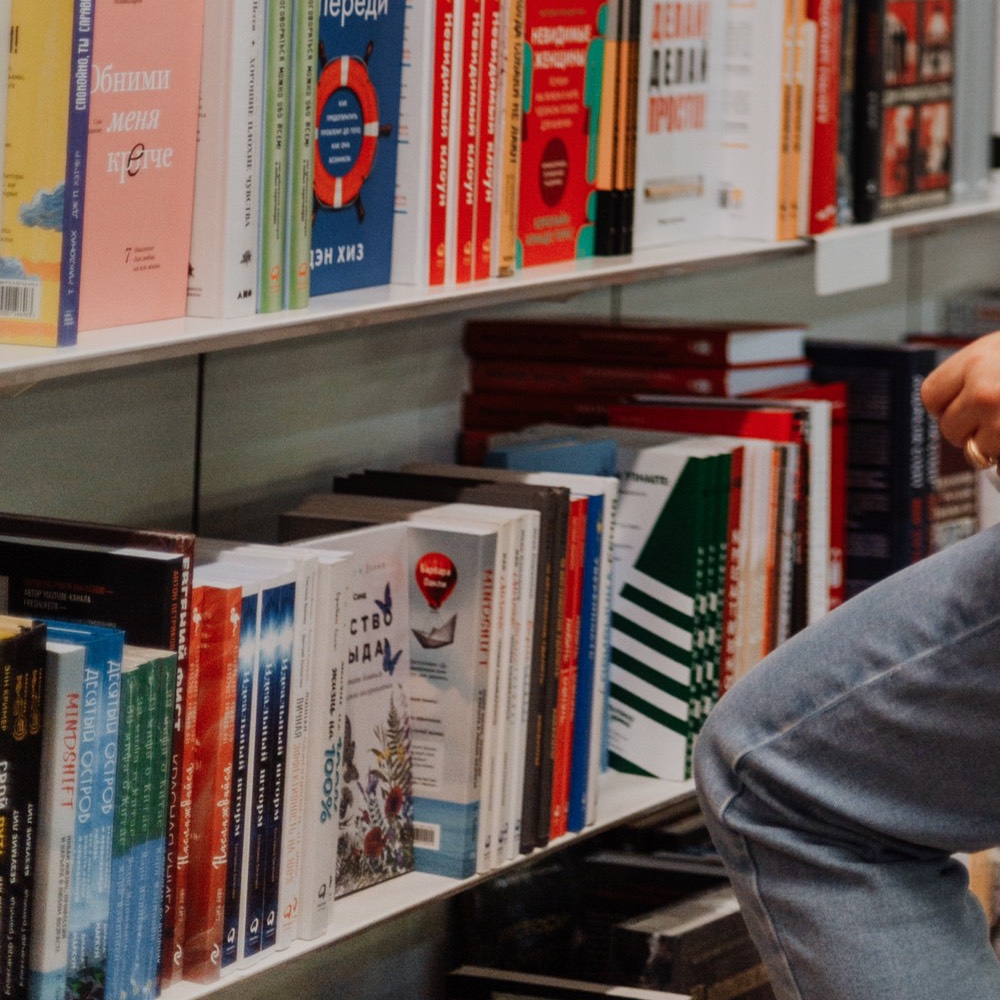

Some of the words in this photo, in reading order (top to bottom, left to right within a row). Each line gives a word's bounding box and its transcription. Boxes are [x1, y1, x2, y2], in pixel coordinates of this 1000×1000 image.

[78, 38, 90, 54] ТЫ
[75, 55, 91, 111] СПОКОЙНО,
[247, 57, 257, 119] ХОРОШИЕ
[277, 66, 286, 98] МОЖНО
[305, 65, 313, 97] МОЖНО
[106, 108, 160, 133] меня
[276, 102, 284, 119] ОБО
[303, 121, 312, 148] ВСЕМ!
[304, 100, 312, 117] ОБО
[245, 121, 255, 172] ПЛОХИЕ
[275, 123, 284, 150] ВСЕМ!
[243, 175, 253, 229] ЧУВСТВА
[68, 229, 78, 286] МАКДОНАХ
[125, 247, 132, 263] 7
[337, 243, 365, 264] ХИЗ
[171, 569, 180, 601] АНТОН
[350, 608, 393, 636] СТВО
[348, 639, 384, 665] ЫДА
[81, 667, 99, 743] ДЕСЯТЫЙ
[104, 660, 120, 734] ДЕСЯТЫЙ
[238, 670, 251, 770] Идеальный
[260, 663, 274, 762] Идеальный
[276, 659, 289, 756] Идеальный
[294, 697, 304, 739] ЛИЧНАЯ
[60, 692, 81, 810] MINDSHIFT
[78, 750, 95, 824] ОСТРОВ
[101, 741, 118, 814] ОСТРОВ
[255, 768, 267, 828] шторм
[272, 762, 283, 821] шторм
[288, 743, 301, 835] ЭФФЕКТИВНОСТЬ
[320, 743, 336, 824] 100%
[233, 777, 245, 837] шторм
[9, 833, 19, 884] БЕЗУМИЕ
[24, 827, 33, 876] БЕЗУМИЕ
